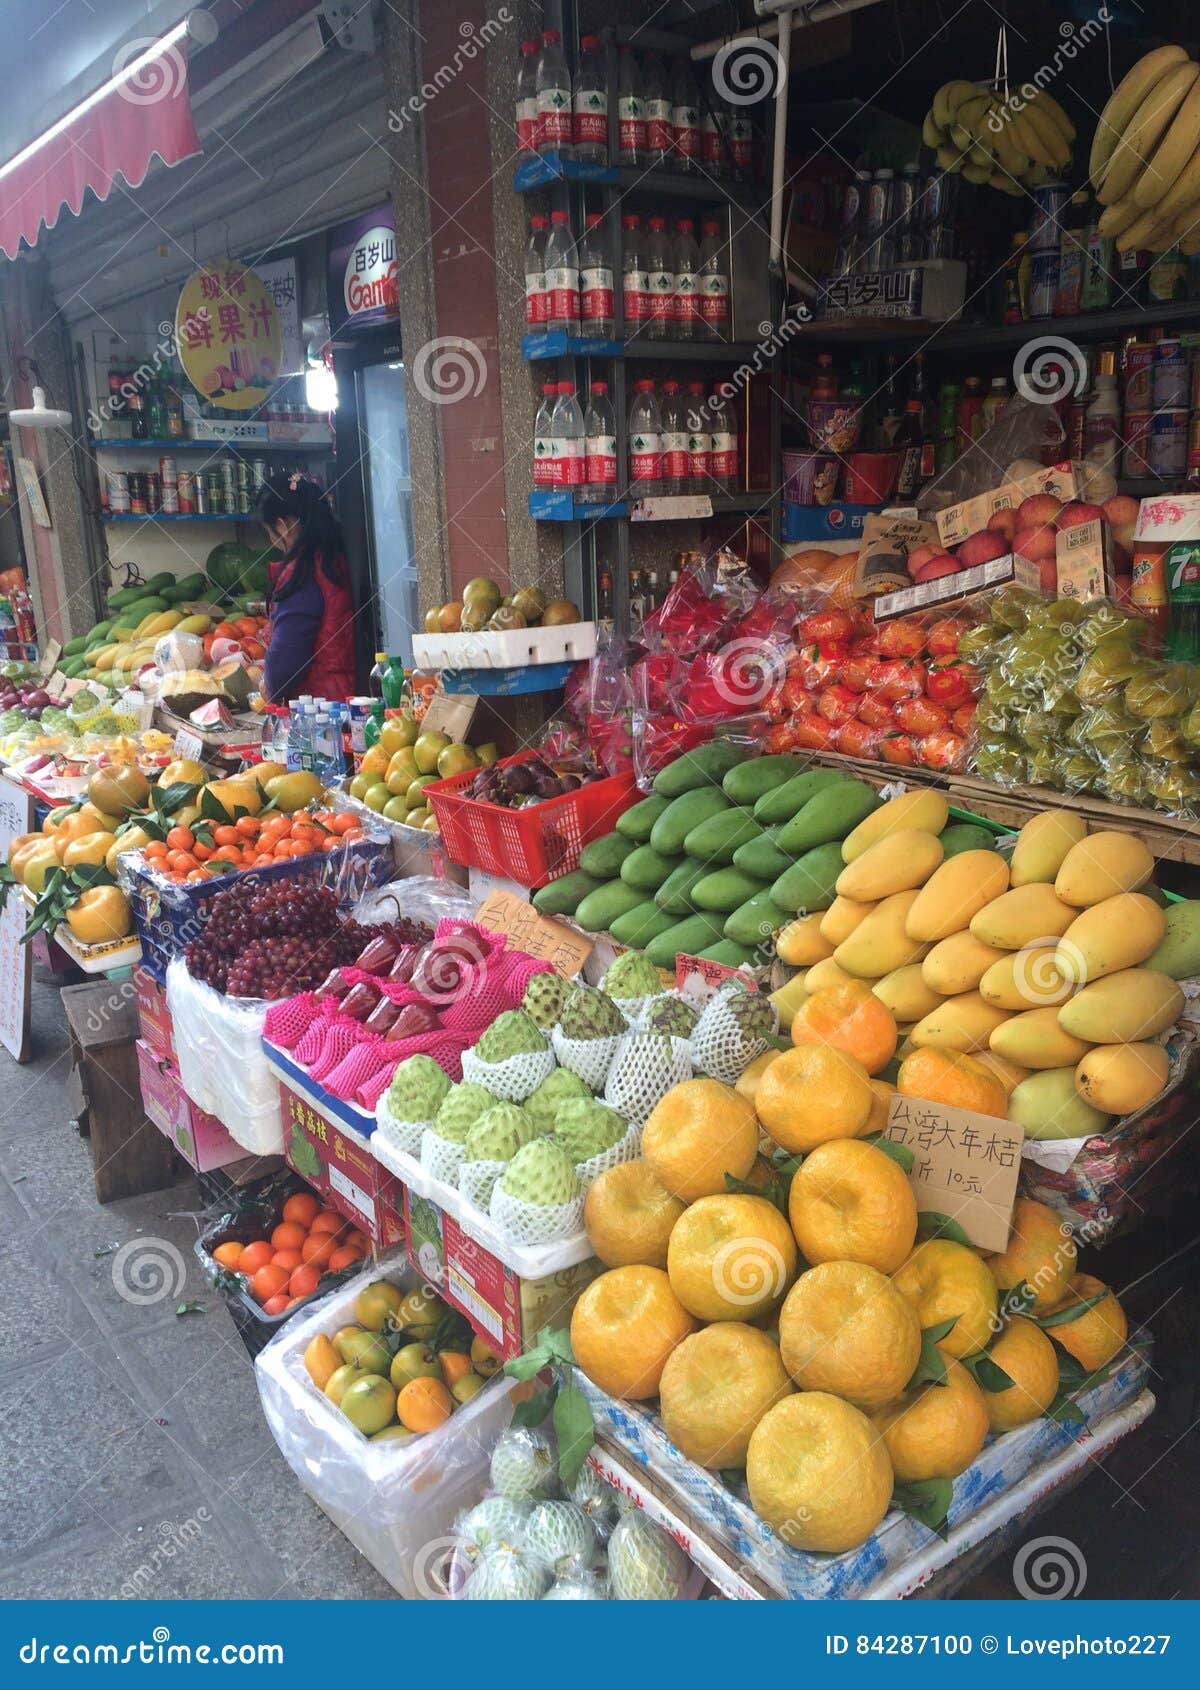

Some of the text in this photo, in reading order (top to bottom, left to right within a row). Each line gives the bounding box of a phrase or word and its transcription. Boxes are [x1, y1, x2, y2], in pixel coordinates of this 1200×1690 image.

[355, 238, 394, 273] 百岁山
[827, 271, 913, 307] 百岁山
[183, 298, 273, 349] 鲜果汁
[888, 1100, 1019, 1167] 台湾大年桔
